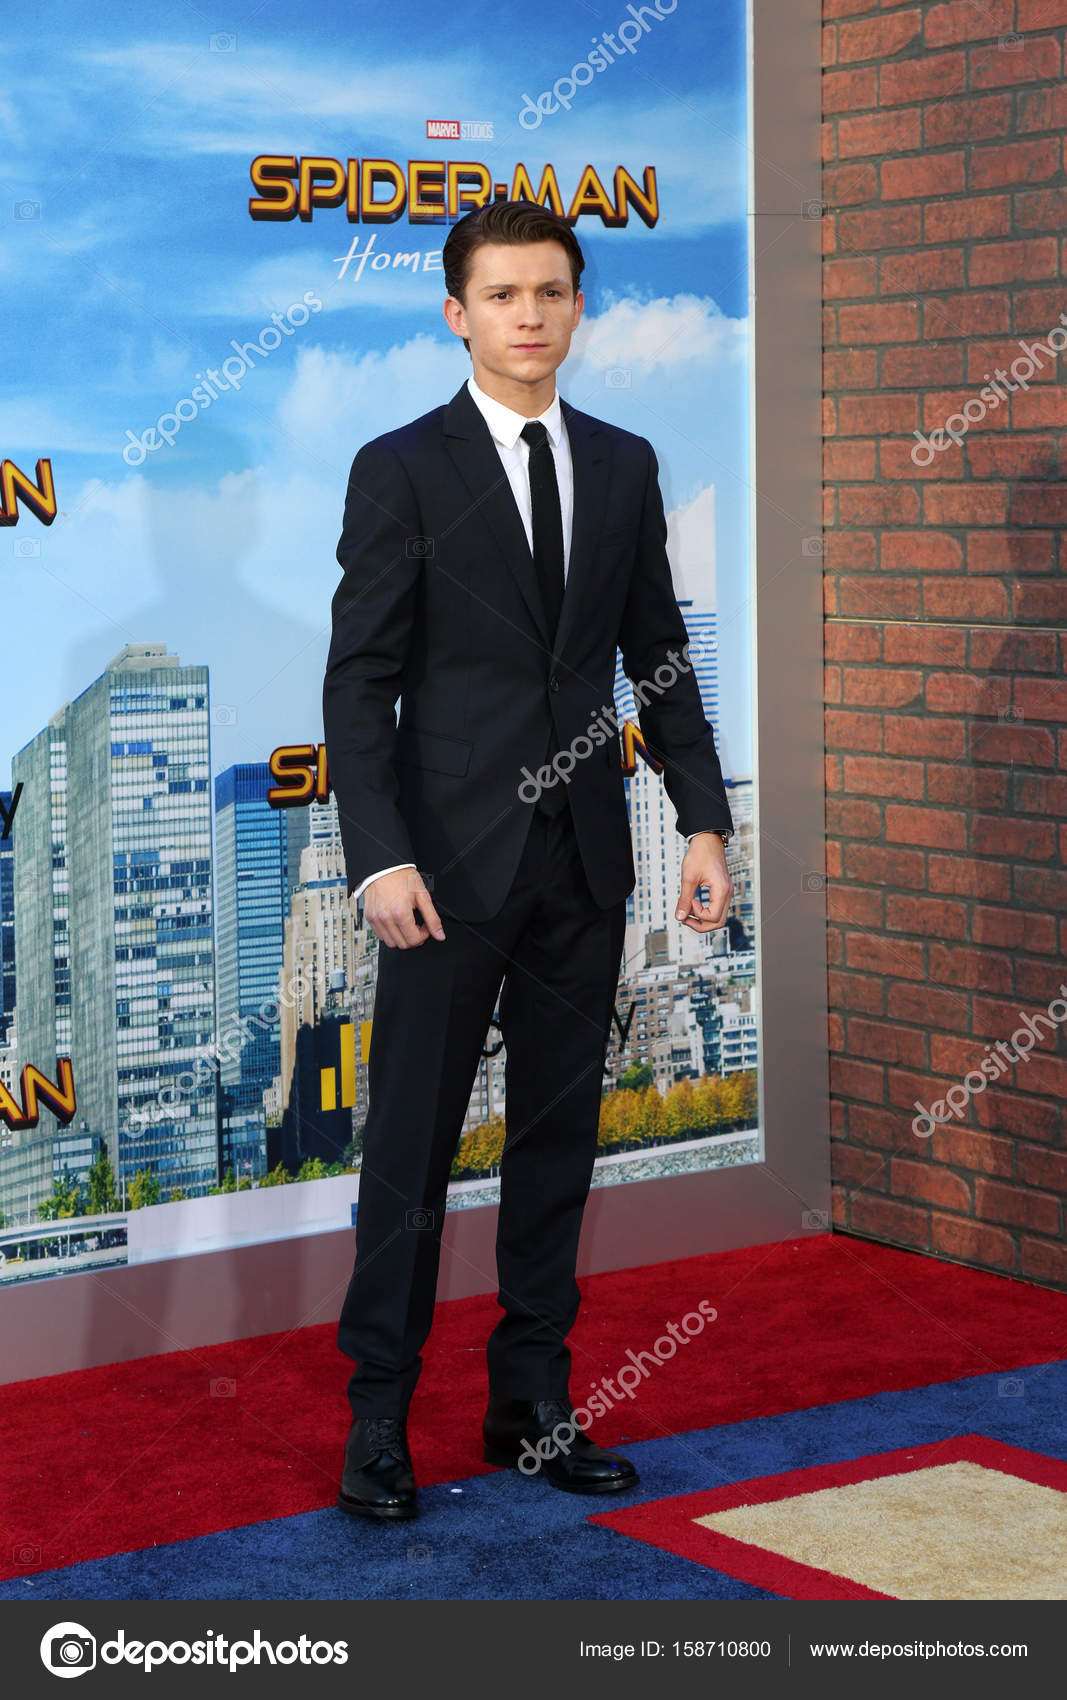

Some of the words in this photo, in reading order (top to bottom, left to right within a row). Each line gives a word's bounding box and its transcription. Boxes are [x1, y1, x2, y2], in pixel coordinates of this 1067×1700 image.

[427, 121, 459, 138] MARVEL
[461, 122, 494, 139] STUDIOS
[249, 155, 659, 229] SPIDER-MAN
